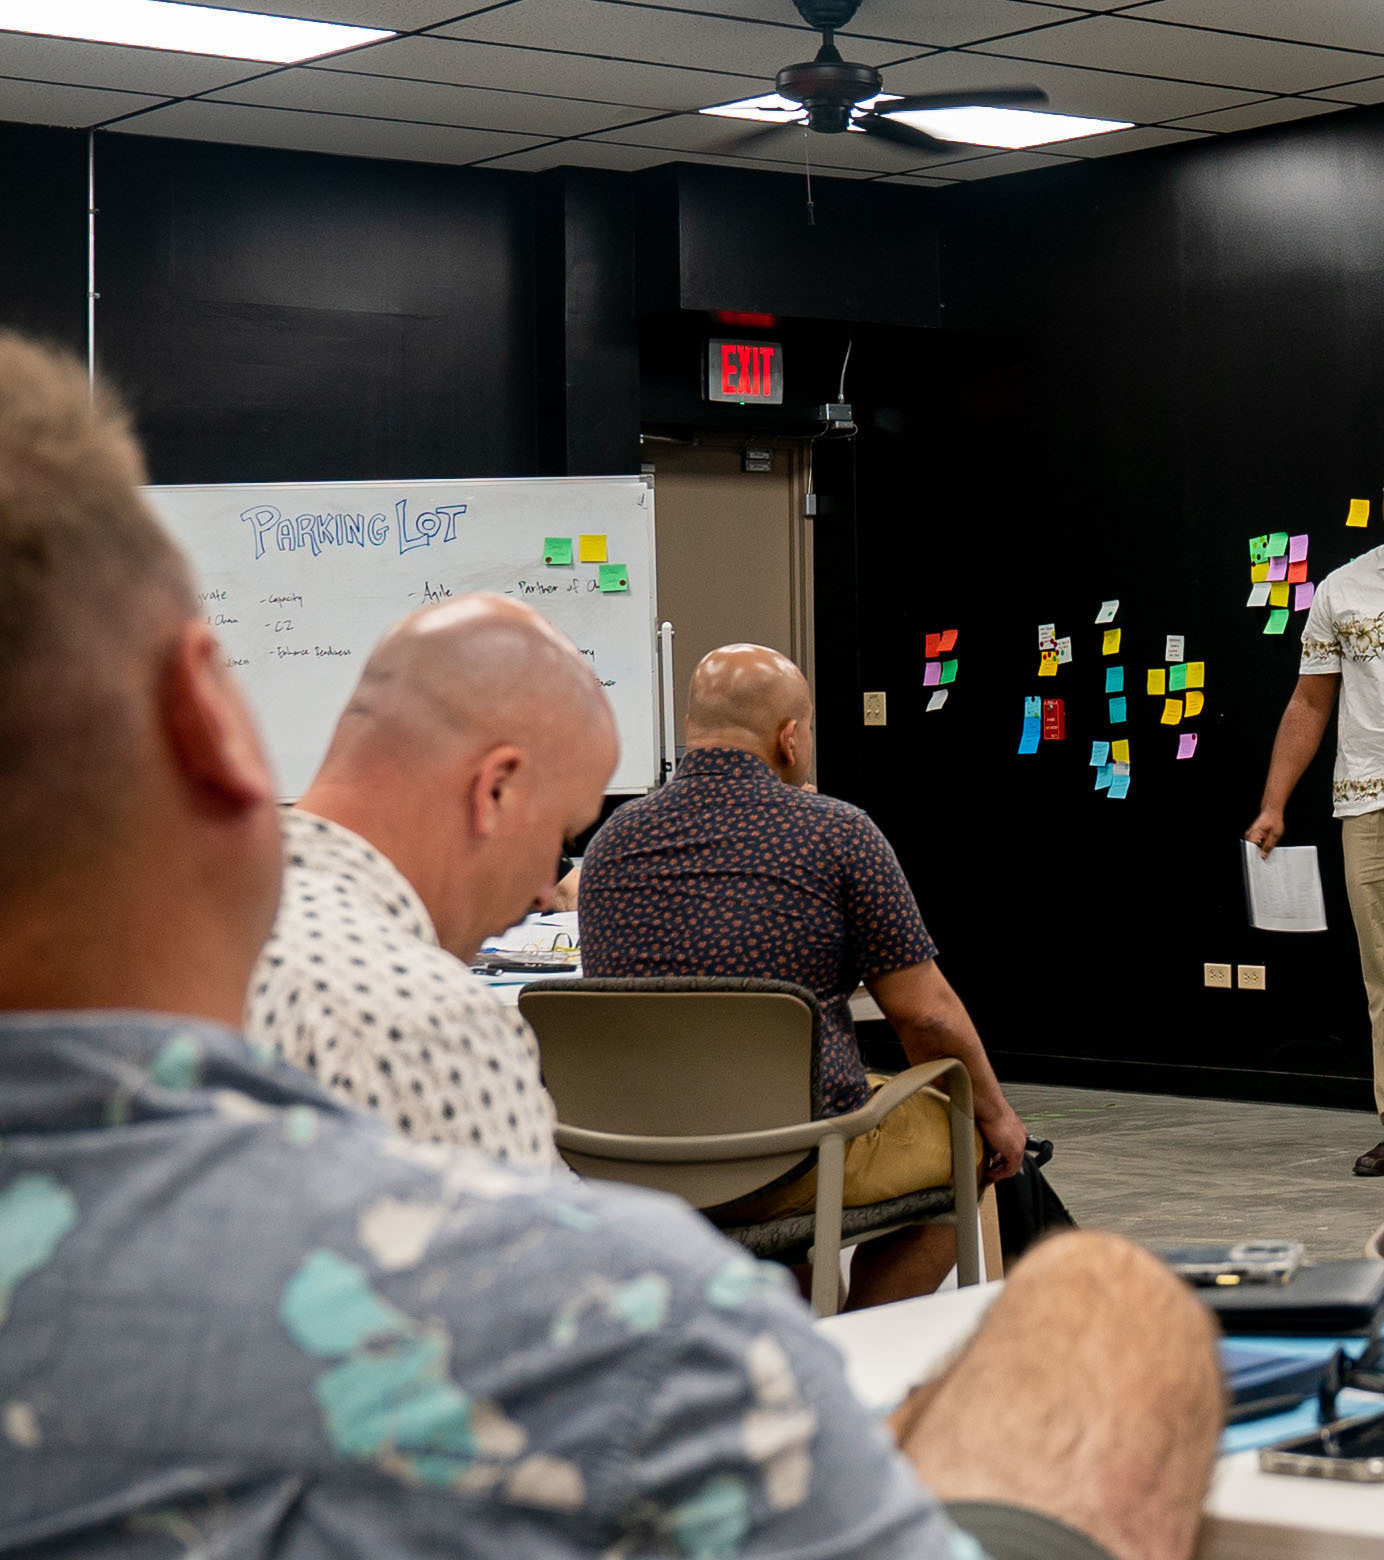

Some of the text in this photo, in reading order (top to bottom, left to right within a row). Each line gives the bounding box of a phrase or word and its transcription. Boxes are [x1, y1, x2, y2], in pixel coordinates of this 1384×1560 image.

[721, 344, 775, 397] EXIT
[240, 499, 467, 560] PARKING LOT
[421, 581, 453, 604] Agile
[518, 580, 559, 595] Partner
[567, 579, 580, 593] of
